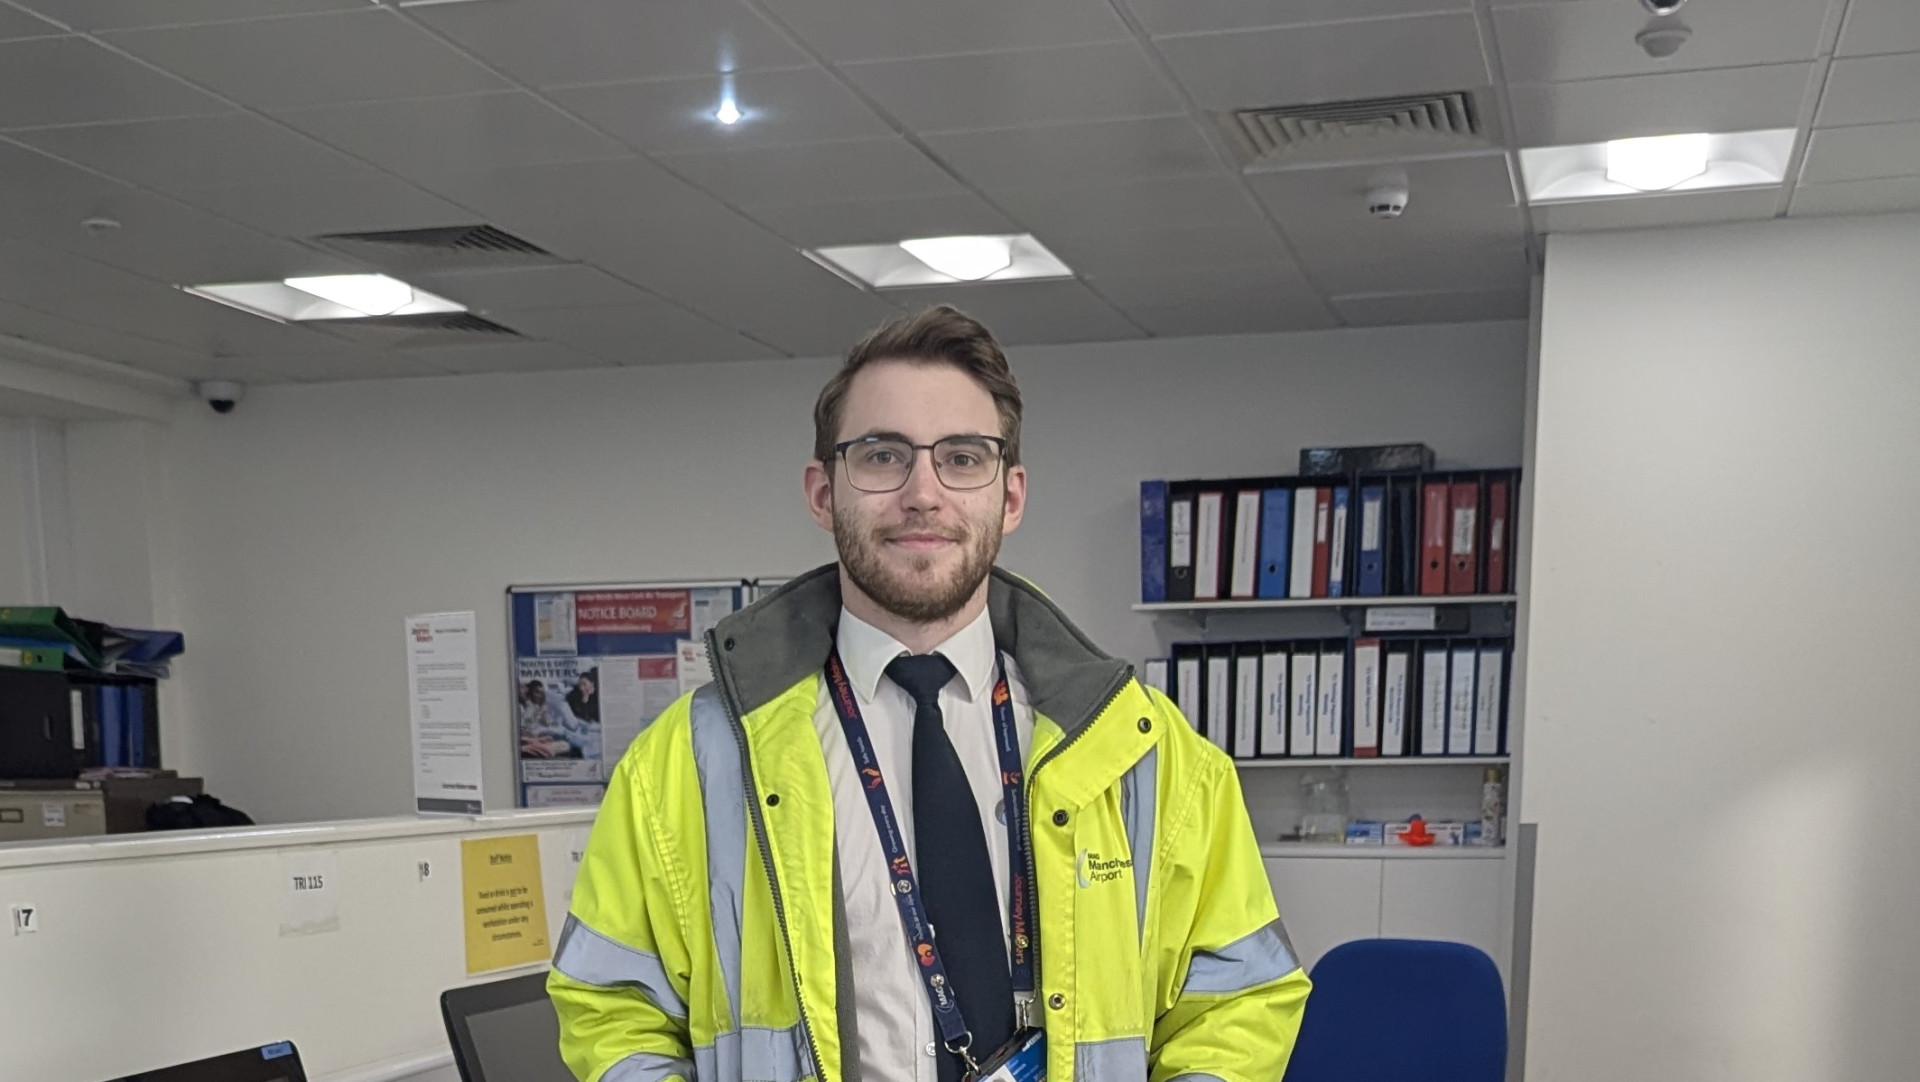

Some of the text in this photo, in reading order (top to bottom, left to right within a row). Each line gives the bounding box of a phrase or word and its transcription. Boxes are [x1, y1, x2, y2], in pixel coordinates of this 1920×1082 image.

[578, 606, 657, 620] NOTICE BOARD
[520, 668, 580, 678] MATTERS
[293, 875, 323, 890] TRI 115
[1090, 869, 1122, 884] Airport
[935, 986, 948, 1006] MAG
